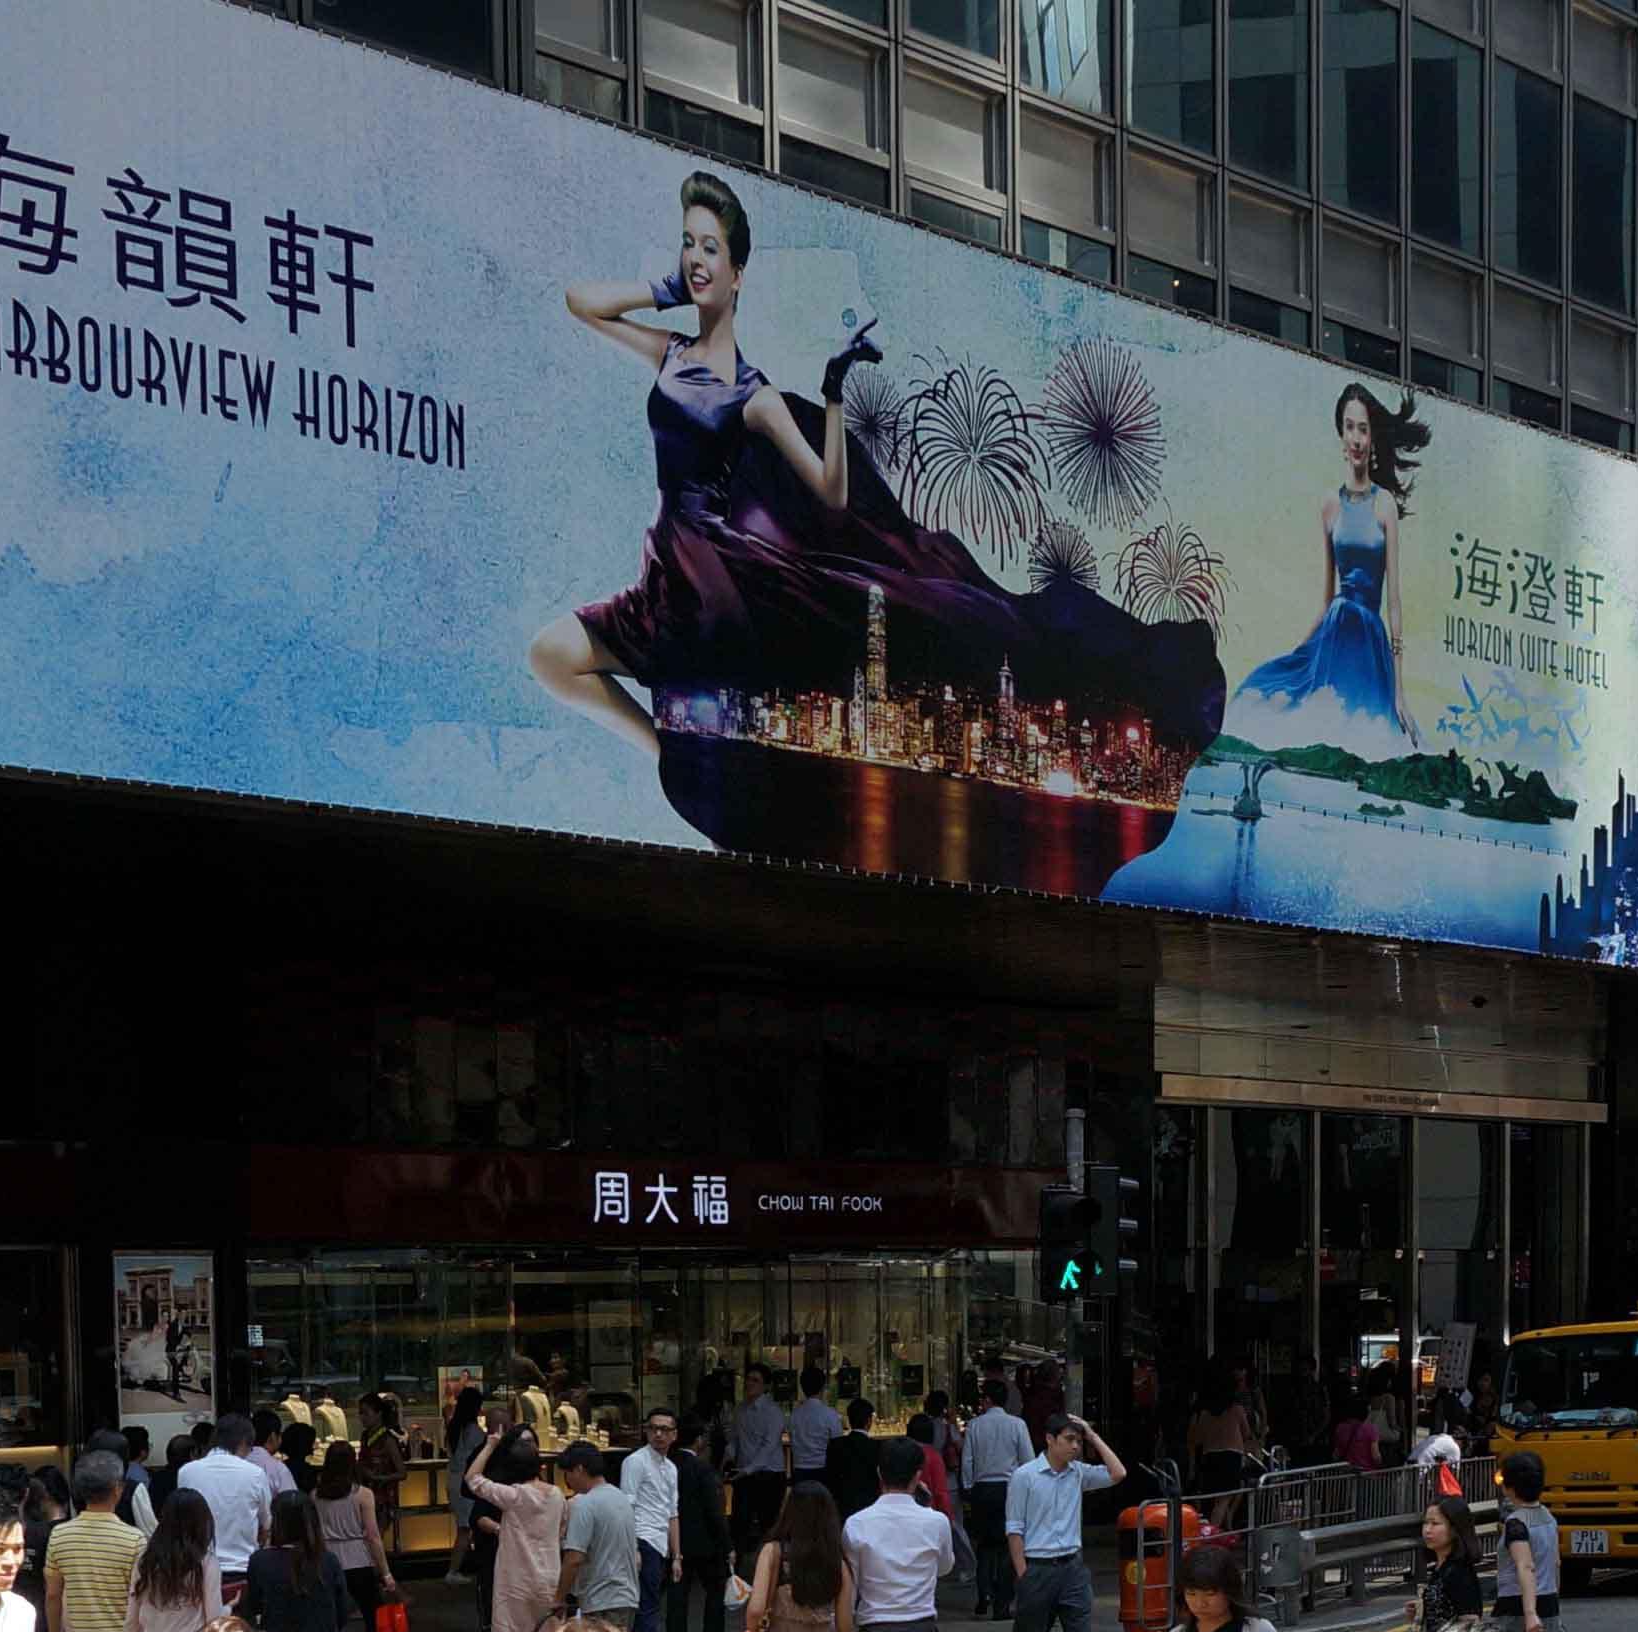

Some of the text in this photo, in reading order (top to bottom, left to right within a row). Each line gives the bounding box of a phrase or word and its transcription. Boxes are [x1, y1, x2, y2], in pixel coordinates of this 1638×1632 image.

[292, 366, 467, 472] HORIZON
[1449, 532, 1605, 636] 海澄軒
[1443, 615, 1609, 690] HORIZON SUITE HOTEL
[592, 1171, 730, 1225] 周大福
[757, 1194, 884, 1213] CHOW TAI FOOK
[1580, 1530, 1599, 1542] PU
